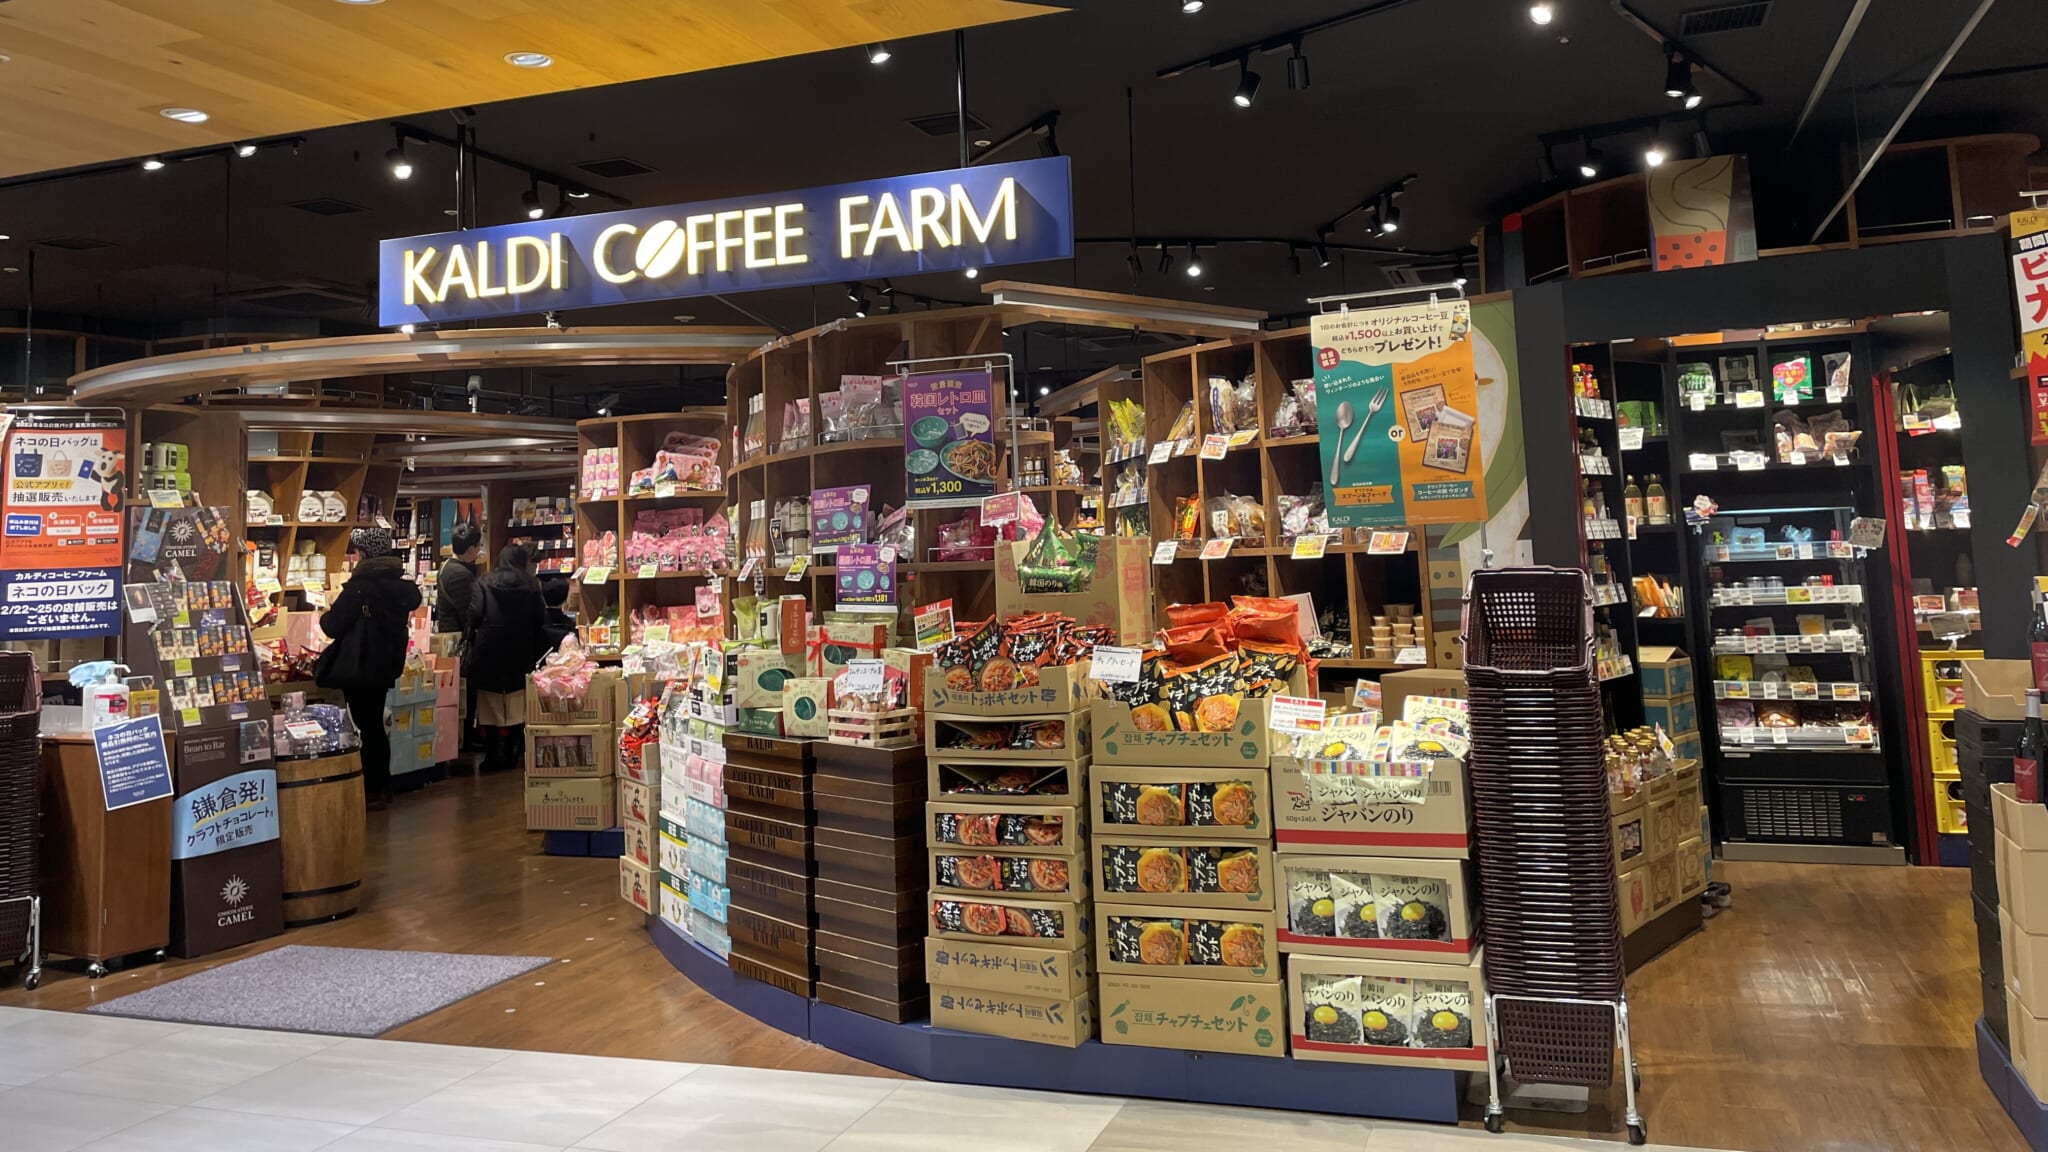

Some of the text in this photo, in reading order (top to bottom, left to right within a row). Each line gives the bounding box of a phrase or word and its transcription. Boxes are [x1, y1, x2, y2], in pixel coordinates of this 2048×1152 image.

[404, 177, 1018, 306] KALDI COFFEE FARM
[1390, 429, 1404, 438] or
[15, 437, 98, 448] ネコの日バッグは
[165, 549, 197, 558] CAMEL
[15, 569, 107, 581] カルディコーヒーファーム
[926, 602, 941, 611] SALE
[1116, 678, 1159, 700] チャプチェ
[1189, 669, 1236, 692] チャプチェ
[971, 690, 1038, 707] トッポギセット
[1202, 684, 1225, 696] セット
[1129, 693, 1152, 706] セット
[1144, 731, 1234, 748] チャプチェセット
[191, 778, 266, 823] 鎌倉発!
[748, 784, 775, 801] KALDI
[1362, 788, 1422, 800] ジャバンのり
[1126, 797, 1137, 821] セット
[1201, 795, 1212, 820] セット
[1321, 806, 1414, 825] ジャバンのり
[750, 834, 776, 849] KALDI
[1126, 860, 1137, 886] セット
[1206, 862, 1217, 886] セット
[1294, 881, 1333, 894] ジャバン
[1380, 882, 1441, 898] ジャバンのり
[217, 910, 255, 927] CAMEL
[1128, 935, 1140, 959] セット
[1208, 936, 1221, 962] セット
[1155, 1012, 1249, 1033] チャプチェセット
